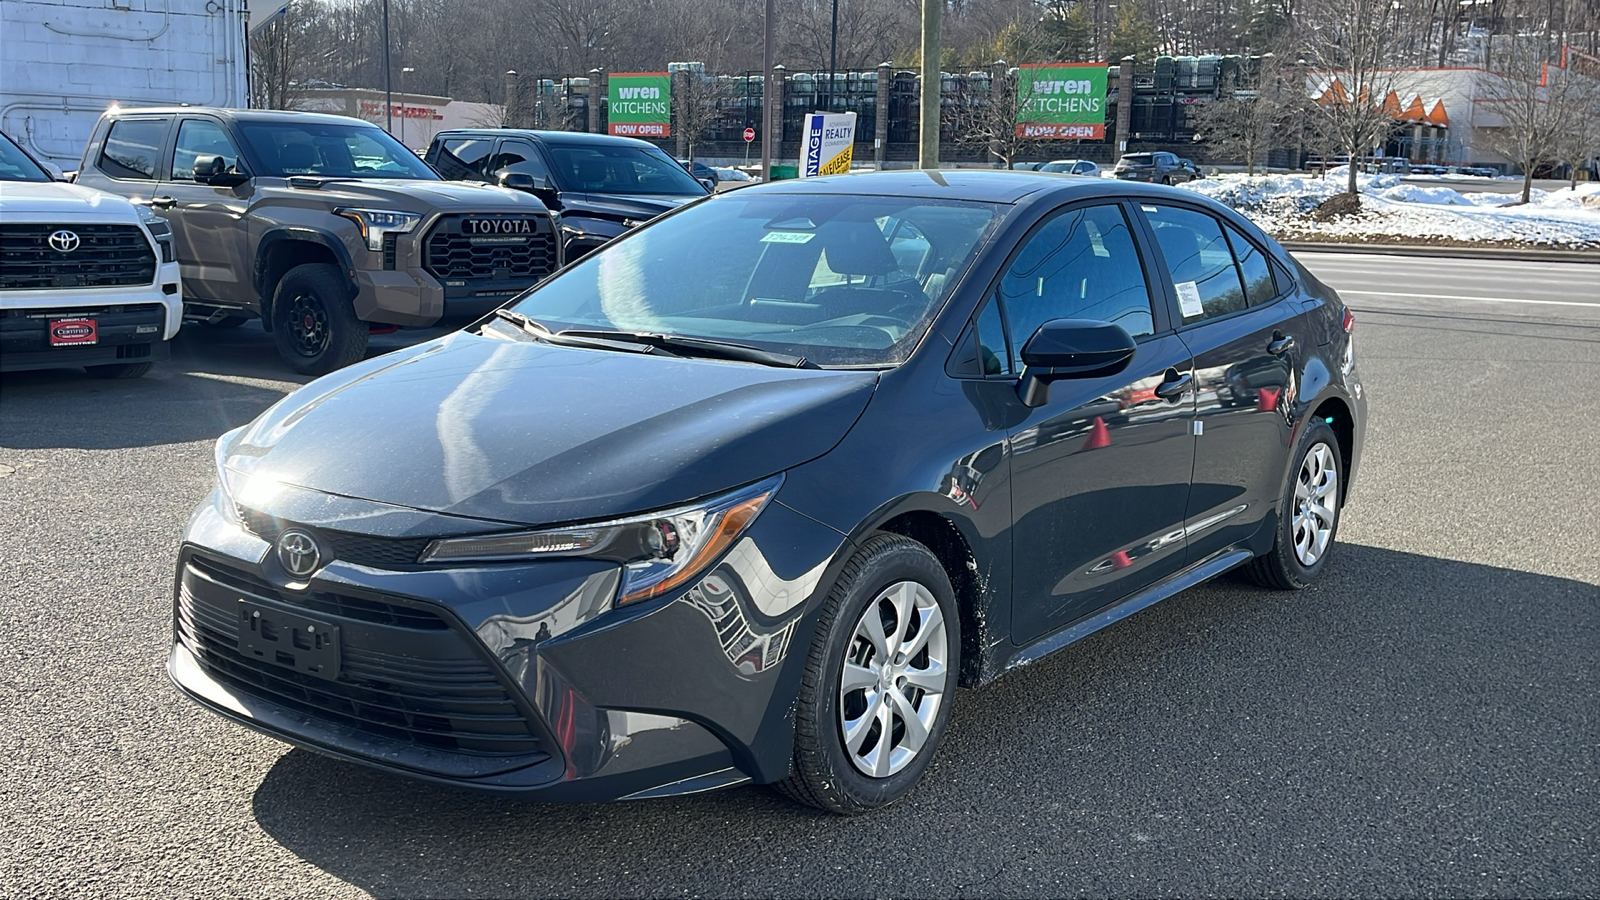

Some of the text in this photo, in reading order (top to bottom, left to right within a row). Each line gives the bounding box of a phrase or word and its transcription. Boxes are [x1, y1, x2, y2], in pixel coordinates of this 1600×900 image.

[1033, 79, 1092, 94] wren
[618, 87, 660, 99] wren
[612, 102, 667, 114] KITCHENS
[1022, 98, 1100, 112] KITCHENS
[615, 125, 663, 134] NOW OPEN
[825, 127, 852, 139] REALTY
[1025, 125, 1094, 137] NOW OPEN
[807, 128, 821, 175] NTAGE
[470, 220, 530, 233] TOYOTA
